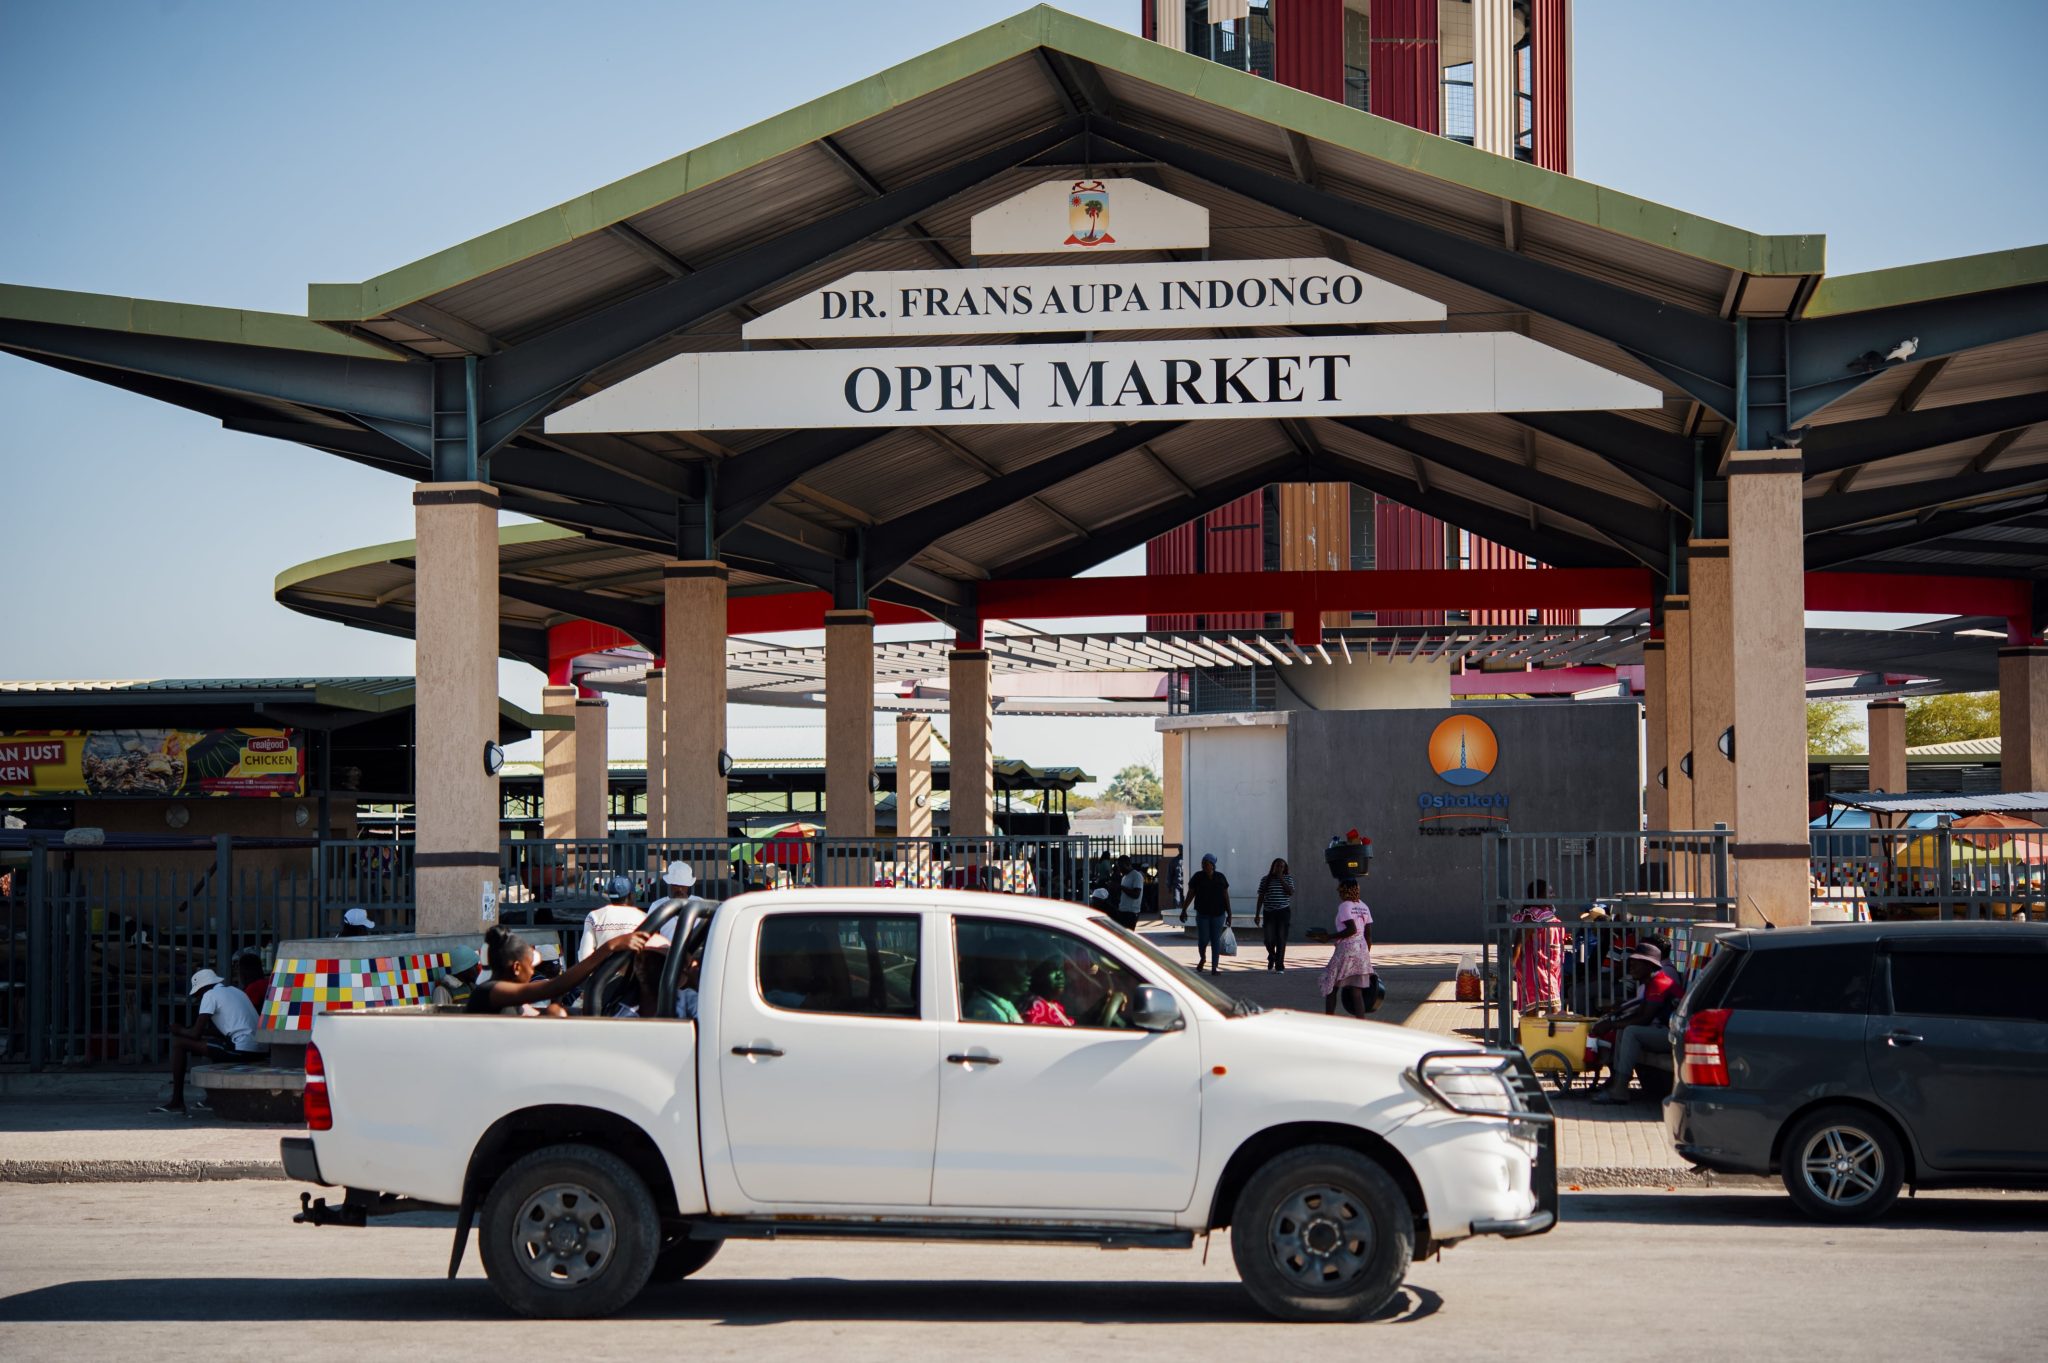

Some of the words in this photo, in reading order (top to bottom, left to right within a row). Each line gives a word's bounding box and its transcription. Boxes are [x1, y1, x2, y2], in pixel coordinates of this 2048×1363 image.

[820, 290, 888, 320] DR.
[900, 285, 1034, 318] FRANS
[1040, 282, 1151, 314] AUPA
[1160, 274, 1364, 311] INDONGO
[844, 362, 1026, 414] OPEN
[1048, 354, 1352, 408] MARKET
[23, 744, 61, 761] JUST
[252, 739, 284, 751] realgood
[244, 755, 293, 766] CHICKEN
[1418, 792, 1509, 809] Oshakati
